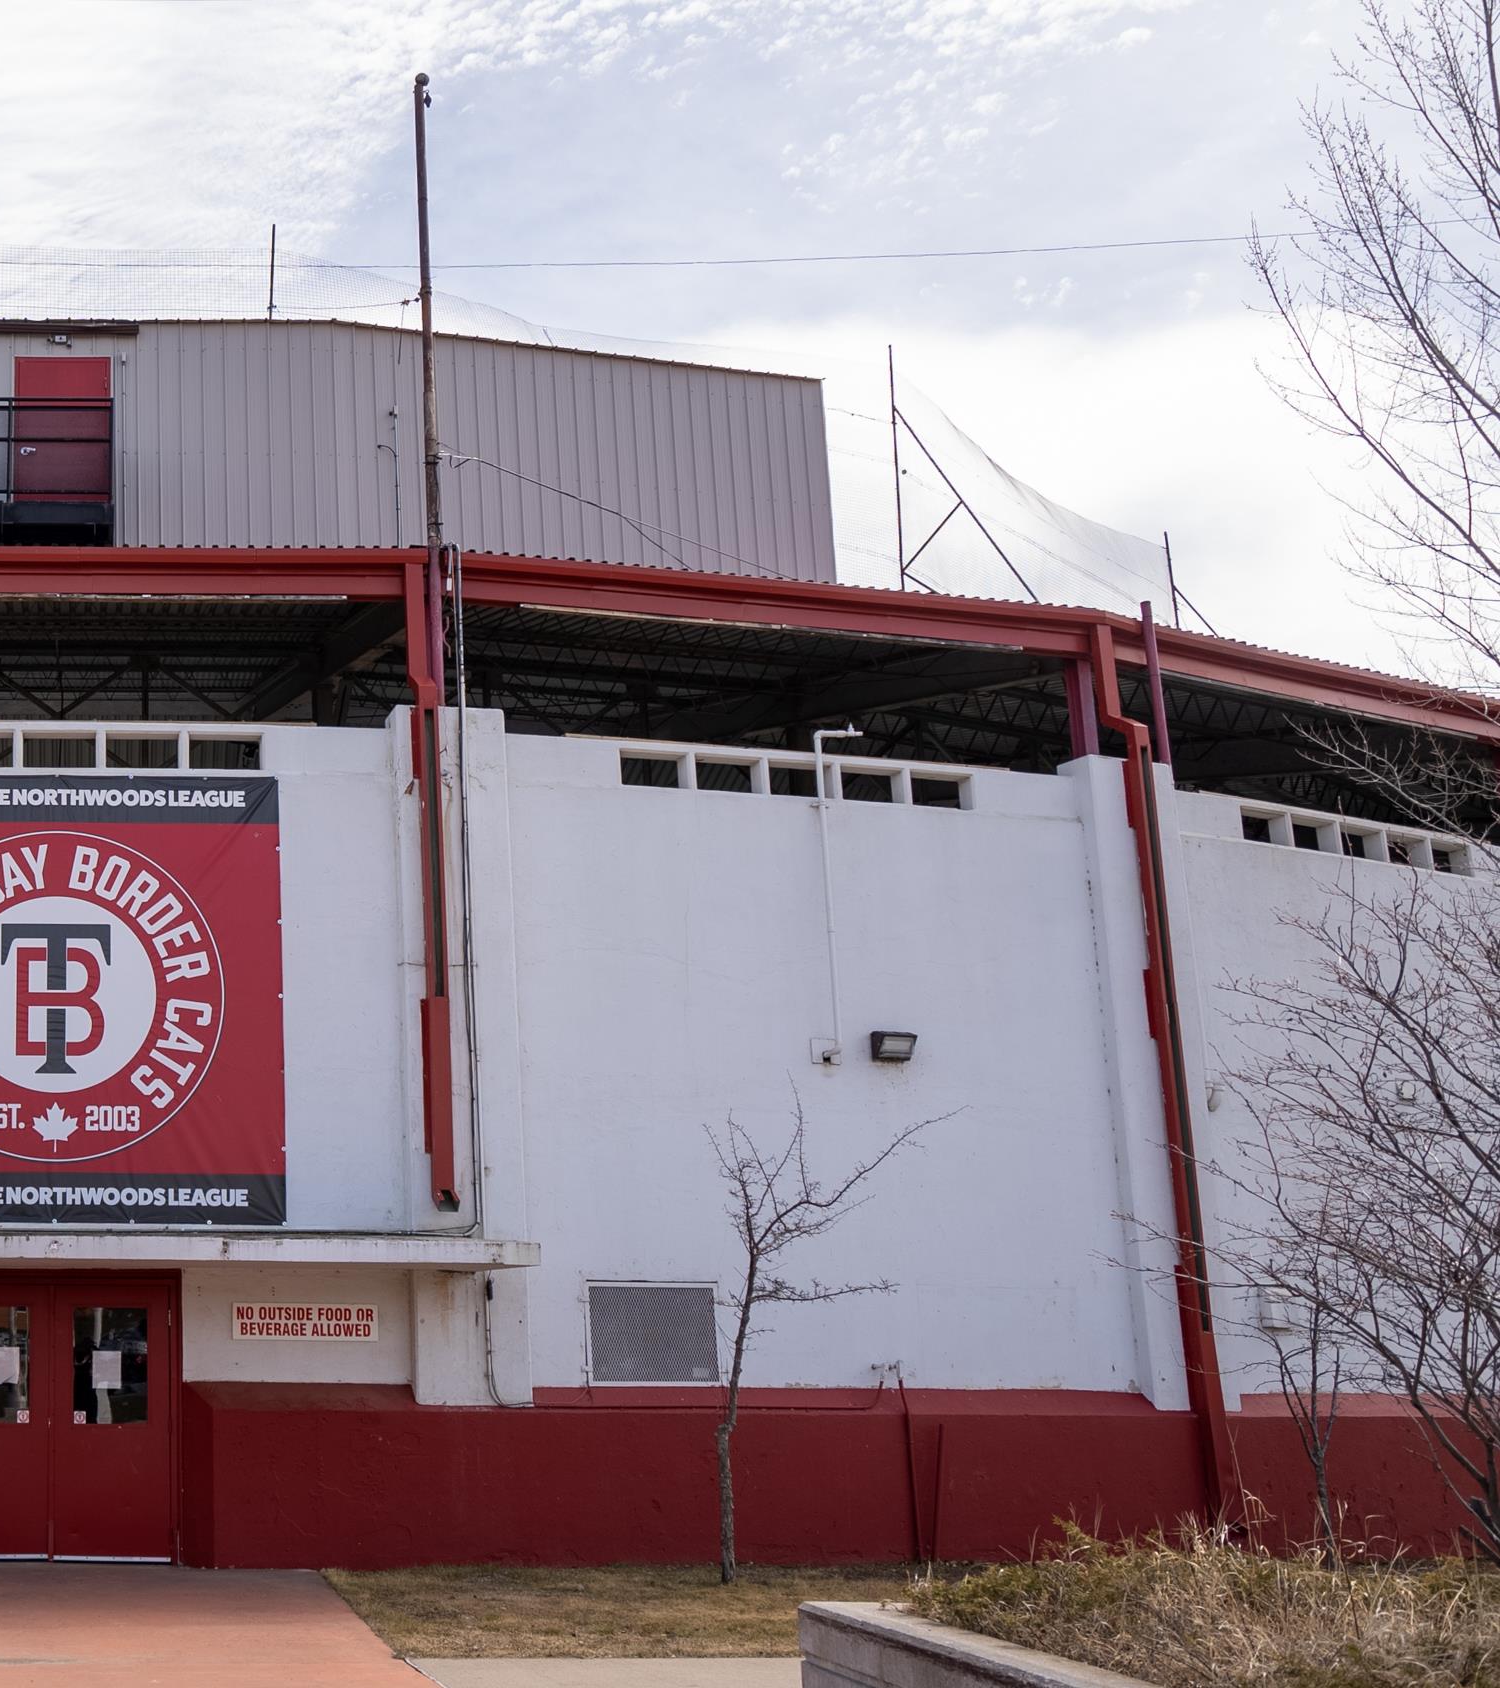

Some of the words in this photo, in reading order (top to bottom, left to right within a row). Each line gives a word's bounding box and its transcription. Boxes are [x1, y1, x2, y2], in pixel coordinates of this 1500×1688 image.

[12, 789, 166, 807] NORTHWOODS
[167, 790, 246, 808] LEAGUE
[68, 845, 211, 983] BORDER
[130, 998, 213, 1109] CATS
[85, 1105, 140, 1132] 2003
[6, 1187, 166, 1206] NORTHWOODS
[168, 1188, 249, 1207] LEAGUE
[236, 1306, 254, 1320] NO
[259, 1307, 313, 1321] OUTSIDE
[317, 1308, 352, 1322] FOOD
[356, 1308, 374, 1322] OR
[240, 1322, 307, 1336] BEVERAGE
[311, 1323, 371, 1337] ALLOWED
